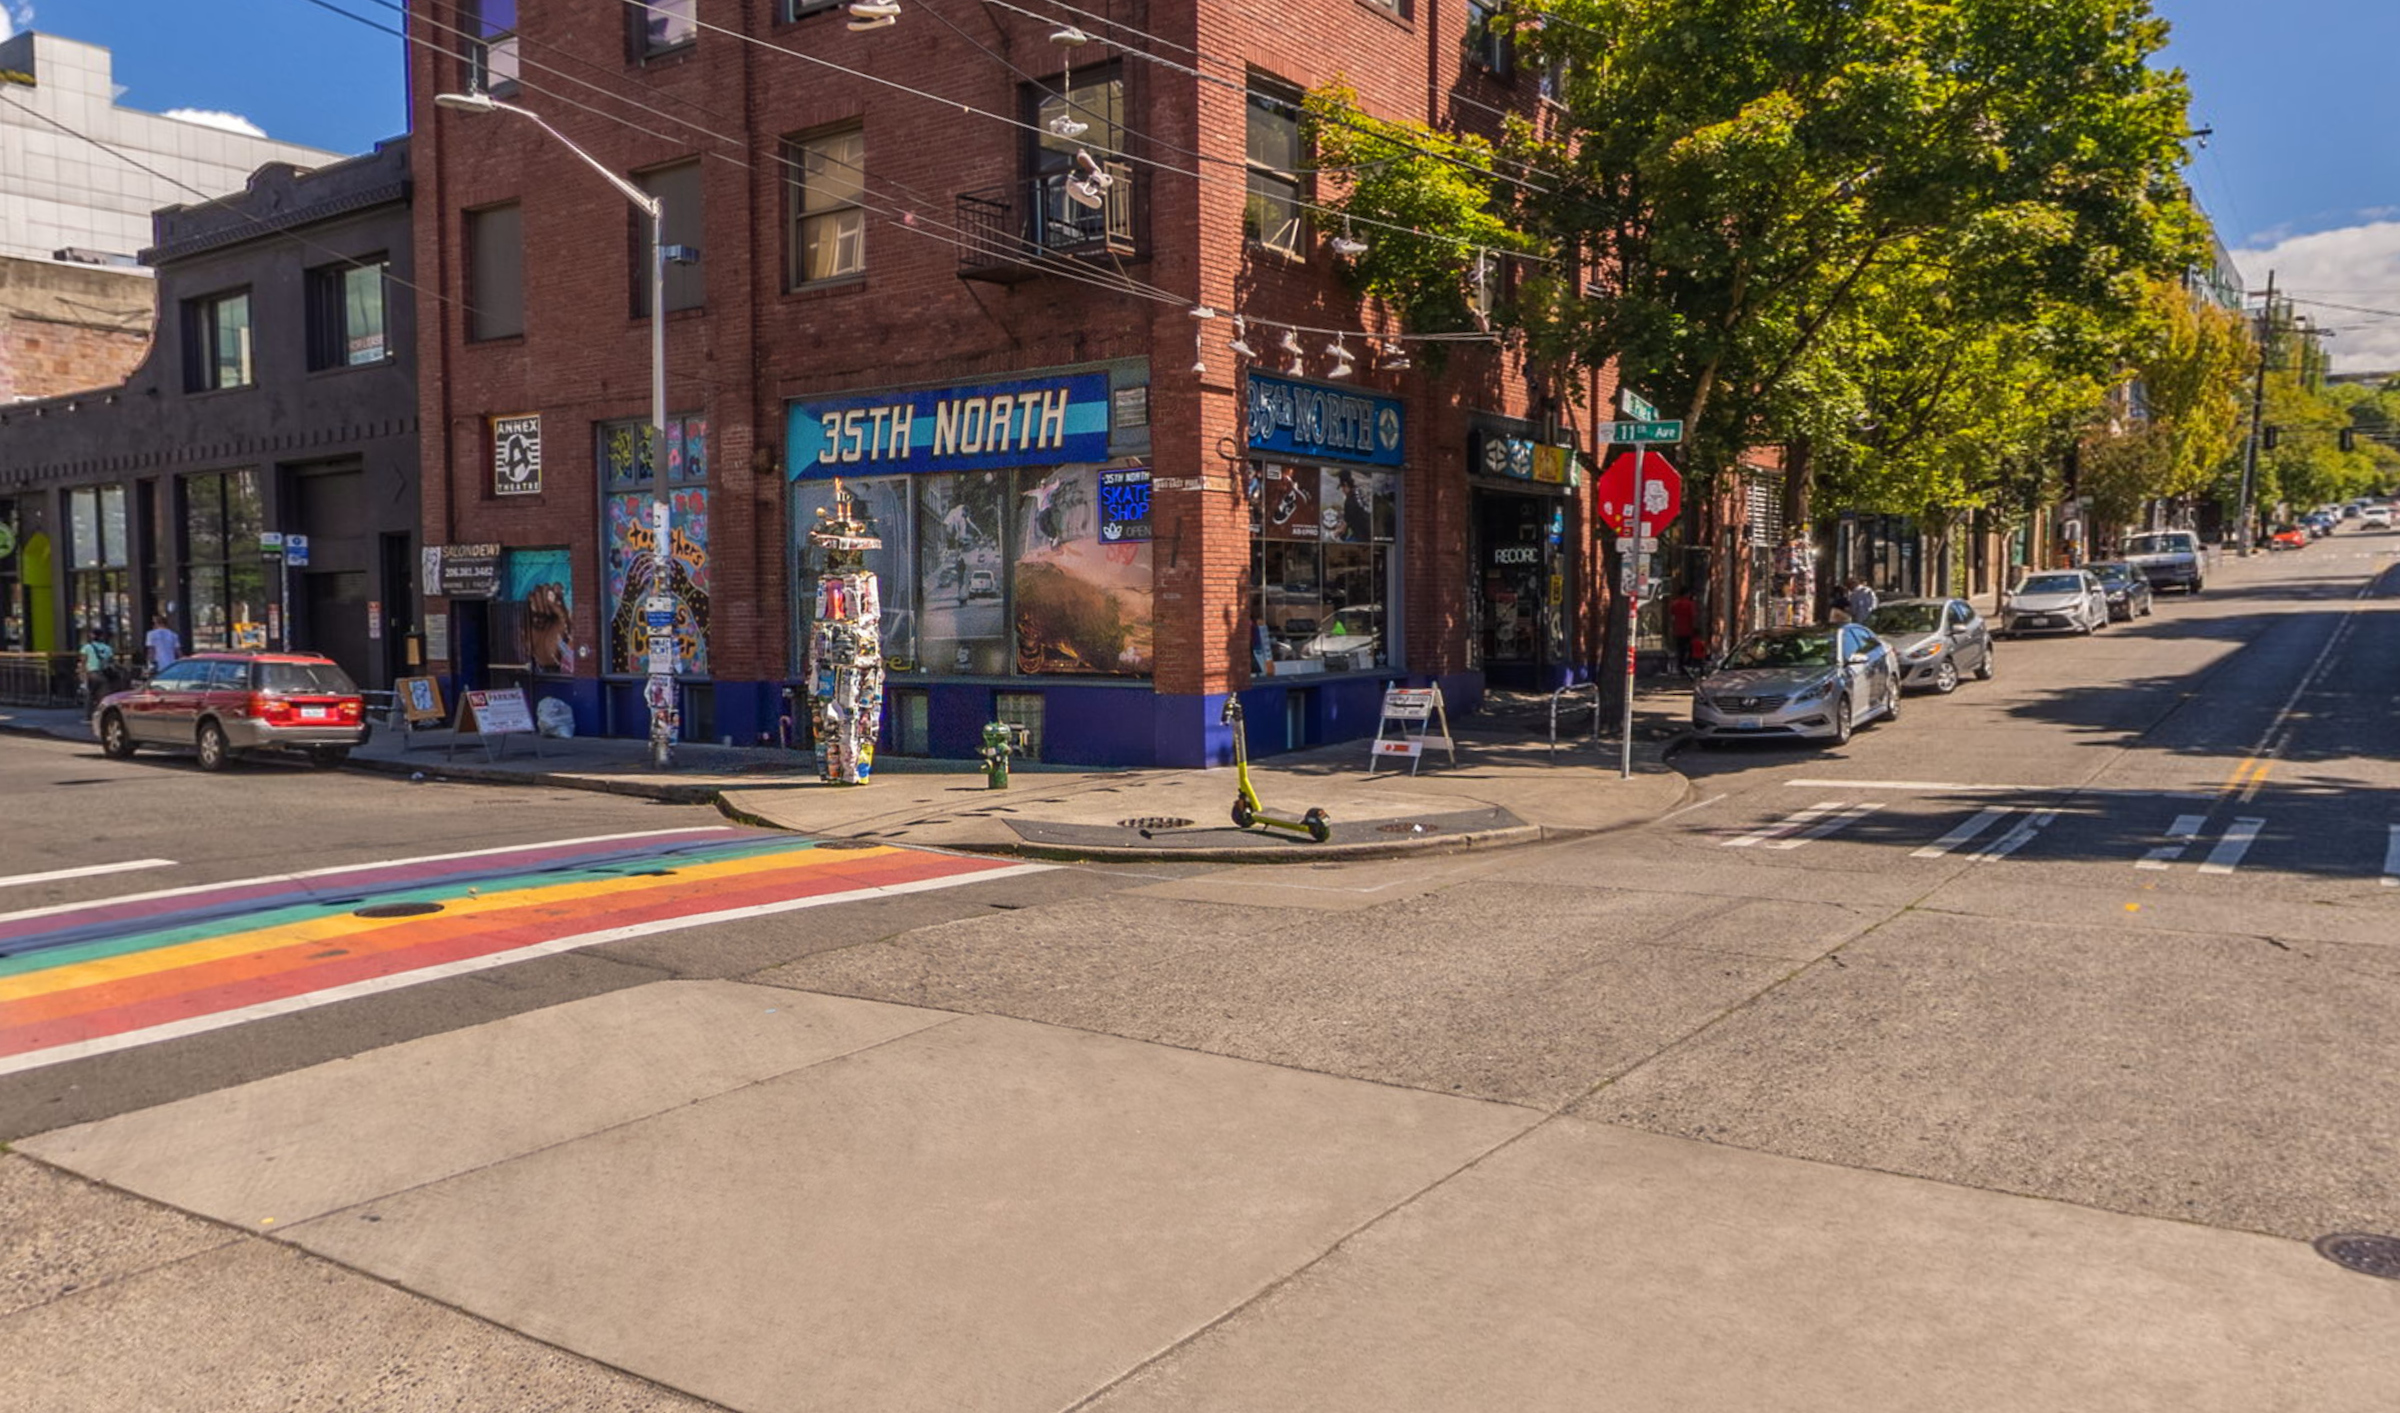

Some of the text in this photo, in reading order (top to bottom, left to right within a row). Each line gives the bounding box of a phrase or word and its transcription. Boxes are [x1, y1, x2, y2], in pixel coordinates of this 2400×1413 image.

[819, 404, 914, 464] 35TH
[933, 388, 1068, 456] NORTH
[1293, 386, 1375, 451] NORTH
[497, 419, 538, 434] ANNEX
[1654, 427, 1676, 438] Ave
[498, 482, 538, 492] THEATRE
[1103, 484, 1152, 504] SKATE
[1109, 502, 1149, 521] SHOP
[1126, 525, 1152, 537] OPEN
[470, 691, 521, 704] NO PARKING
